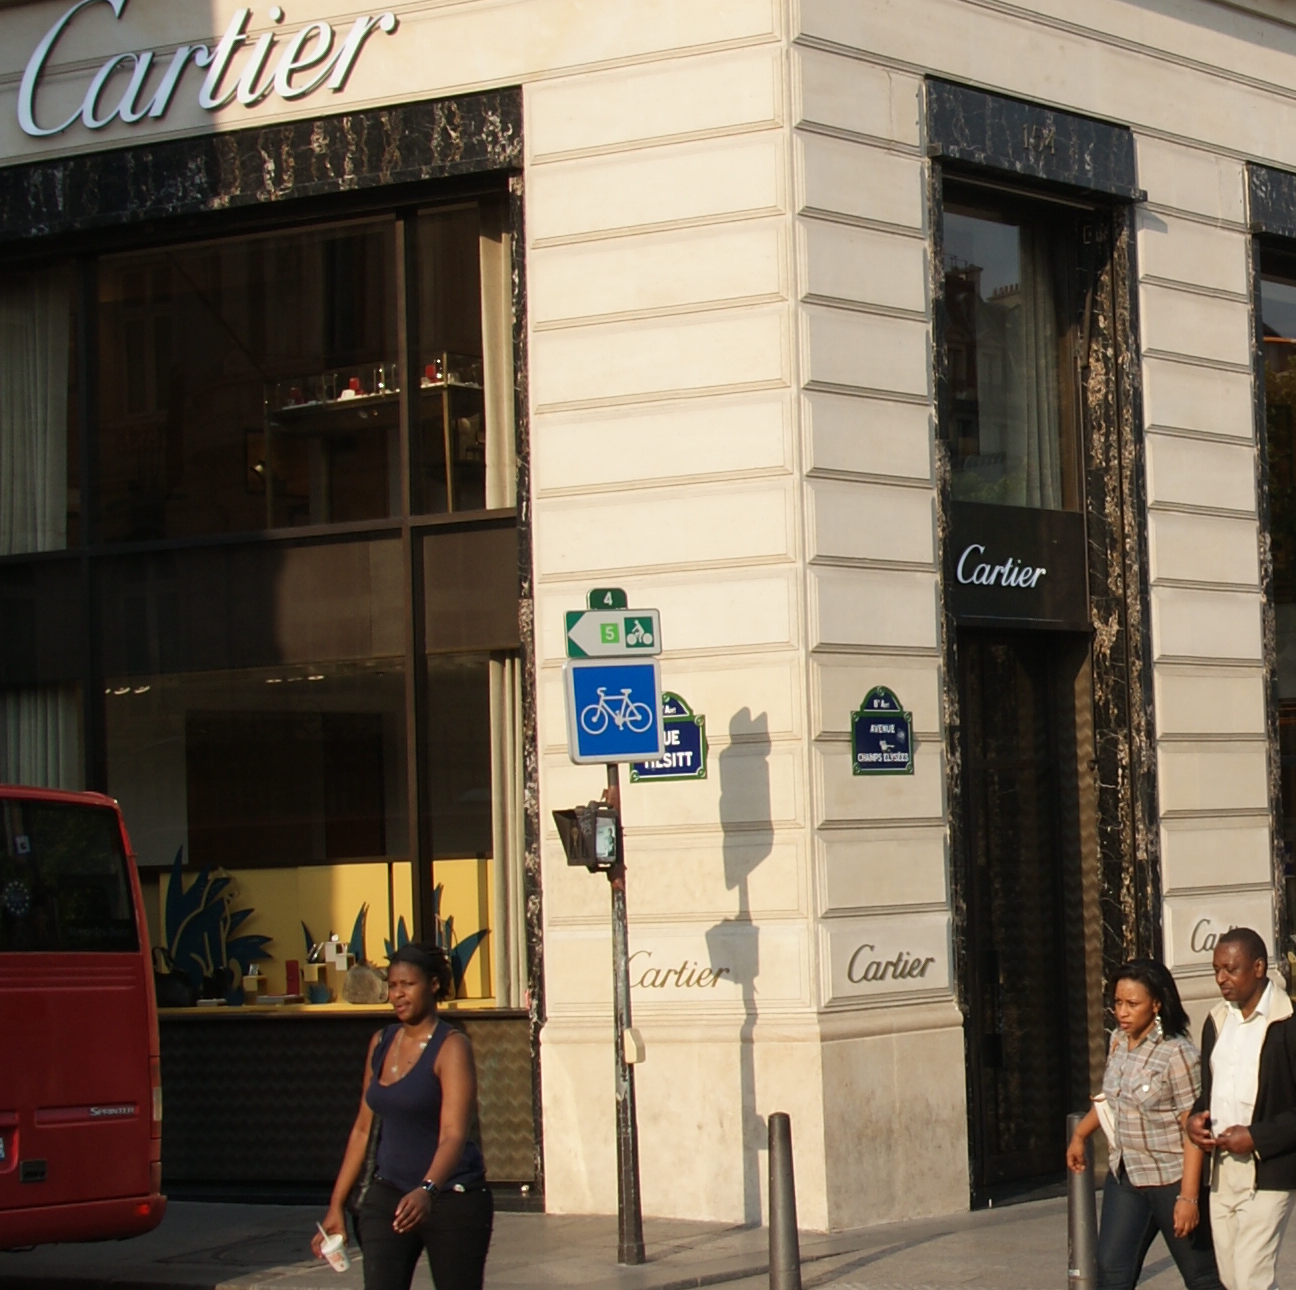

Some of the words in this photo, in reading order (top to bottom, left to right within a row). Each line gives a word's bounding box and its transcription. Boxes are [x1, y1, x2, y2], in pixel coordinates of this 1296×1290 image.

[957, 544, 1046, 588] Cartier
[604, 591, 613, 606] 4
[604, 625, 615, 641] 5
[870, 724, 896, 734] AVENUE
[663, 730, 680, 746] UE
[857, 752, 882, 762] CHAMPS
[628, 950, 730, 989] Cartier
[847, 944, 935, 984] Cartier
